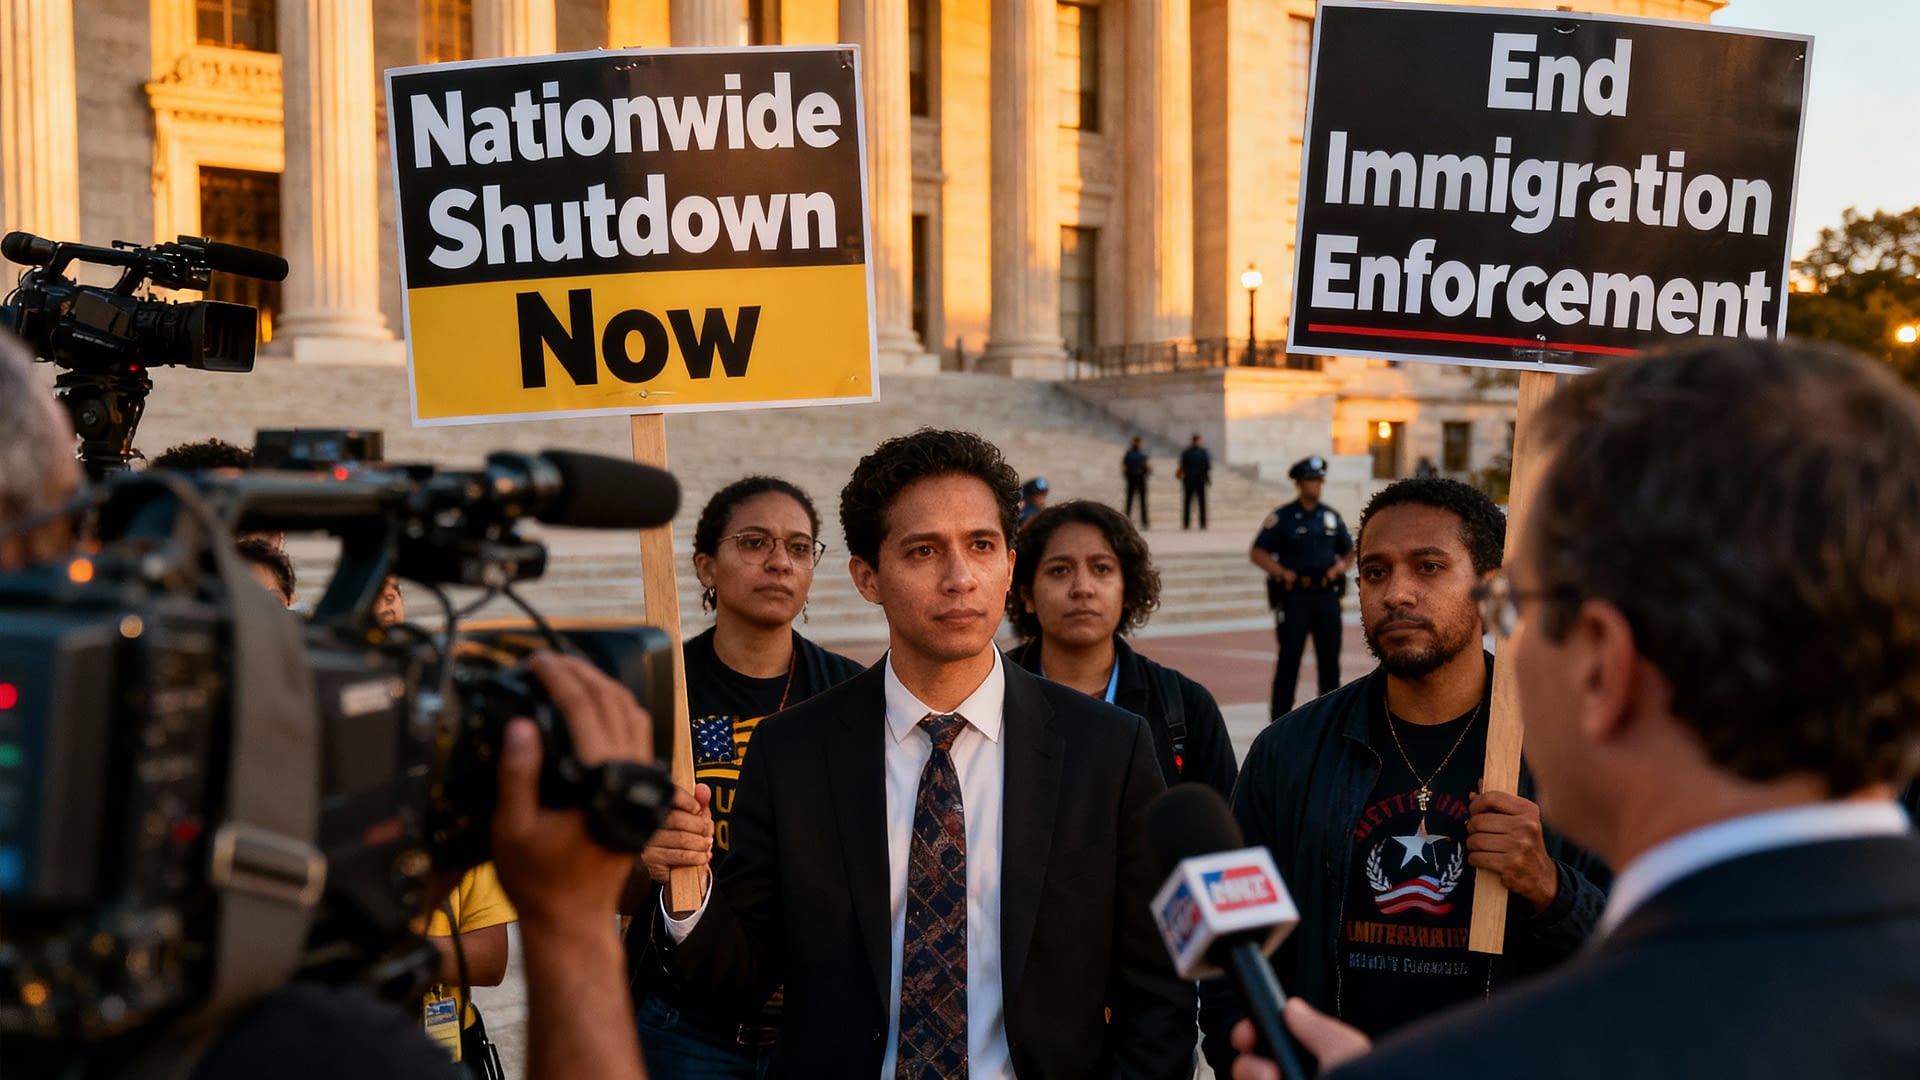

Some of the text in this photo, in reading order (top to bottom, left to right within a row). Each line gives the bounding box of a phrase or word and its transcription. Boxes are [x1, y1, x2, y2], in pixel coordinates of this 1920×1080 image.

[410, 72, 842, 169] Nationwide
[1487, 33, 1633, 117] End
[428, 174, 838, 269] Shutdown
[1324, 131, 1773, 236] Immigration
[1310, 234, 1772, 340] Enforcement
[516, 288, 761, 390] Now
